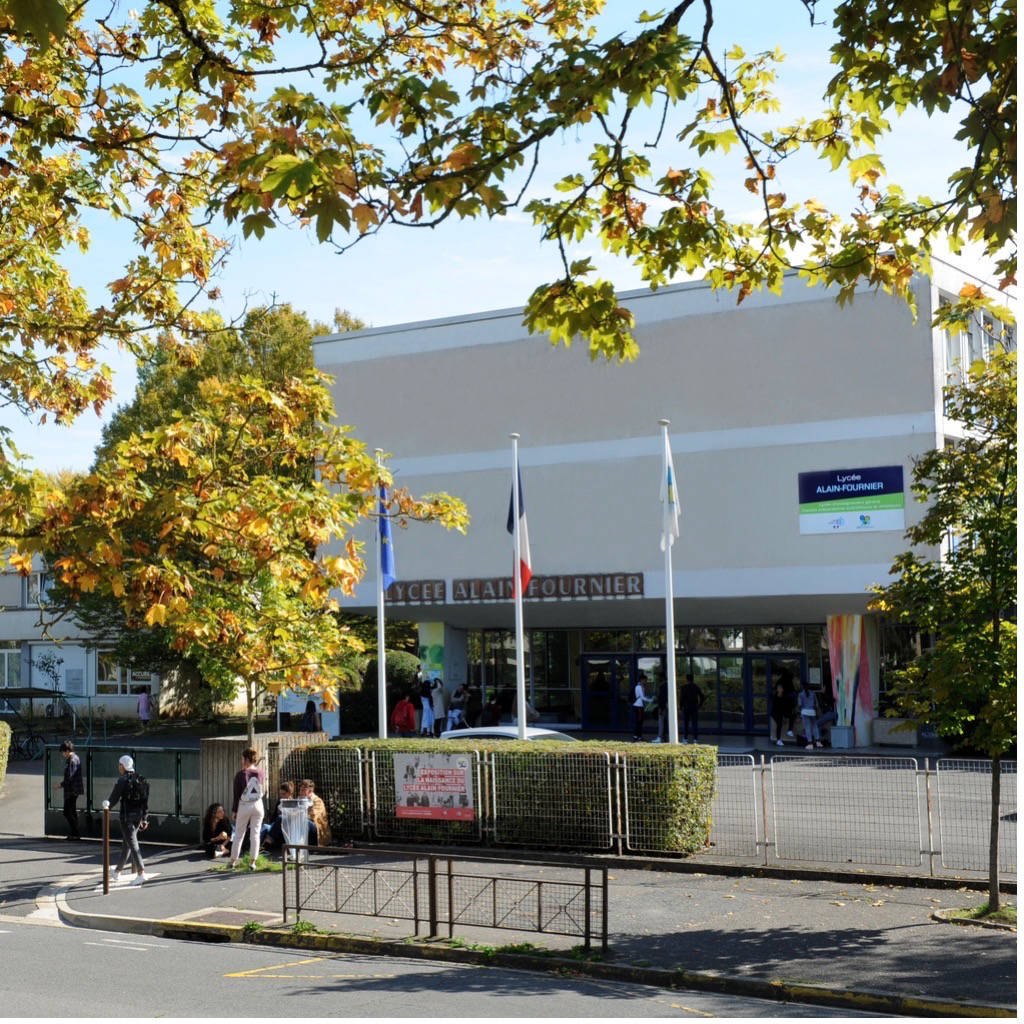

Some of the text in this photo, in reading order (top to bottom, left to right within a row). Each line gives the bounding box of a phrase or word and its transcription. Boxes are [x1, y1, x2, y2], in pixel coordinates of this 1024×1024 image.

[837, 473, 861, 483] Lycée
[816, 481, 883, 494] ALAIN-FOURNIER
[529, 575, 642, 597] FOURNIER
